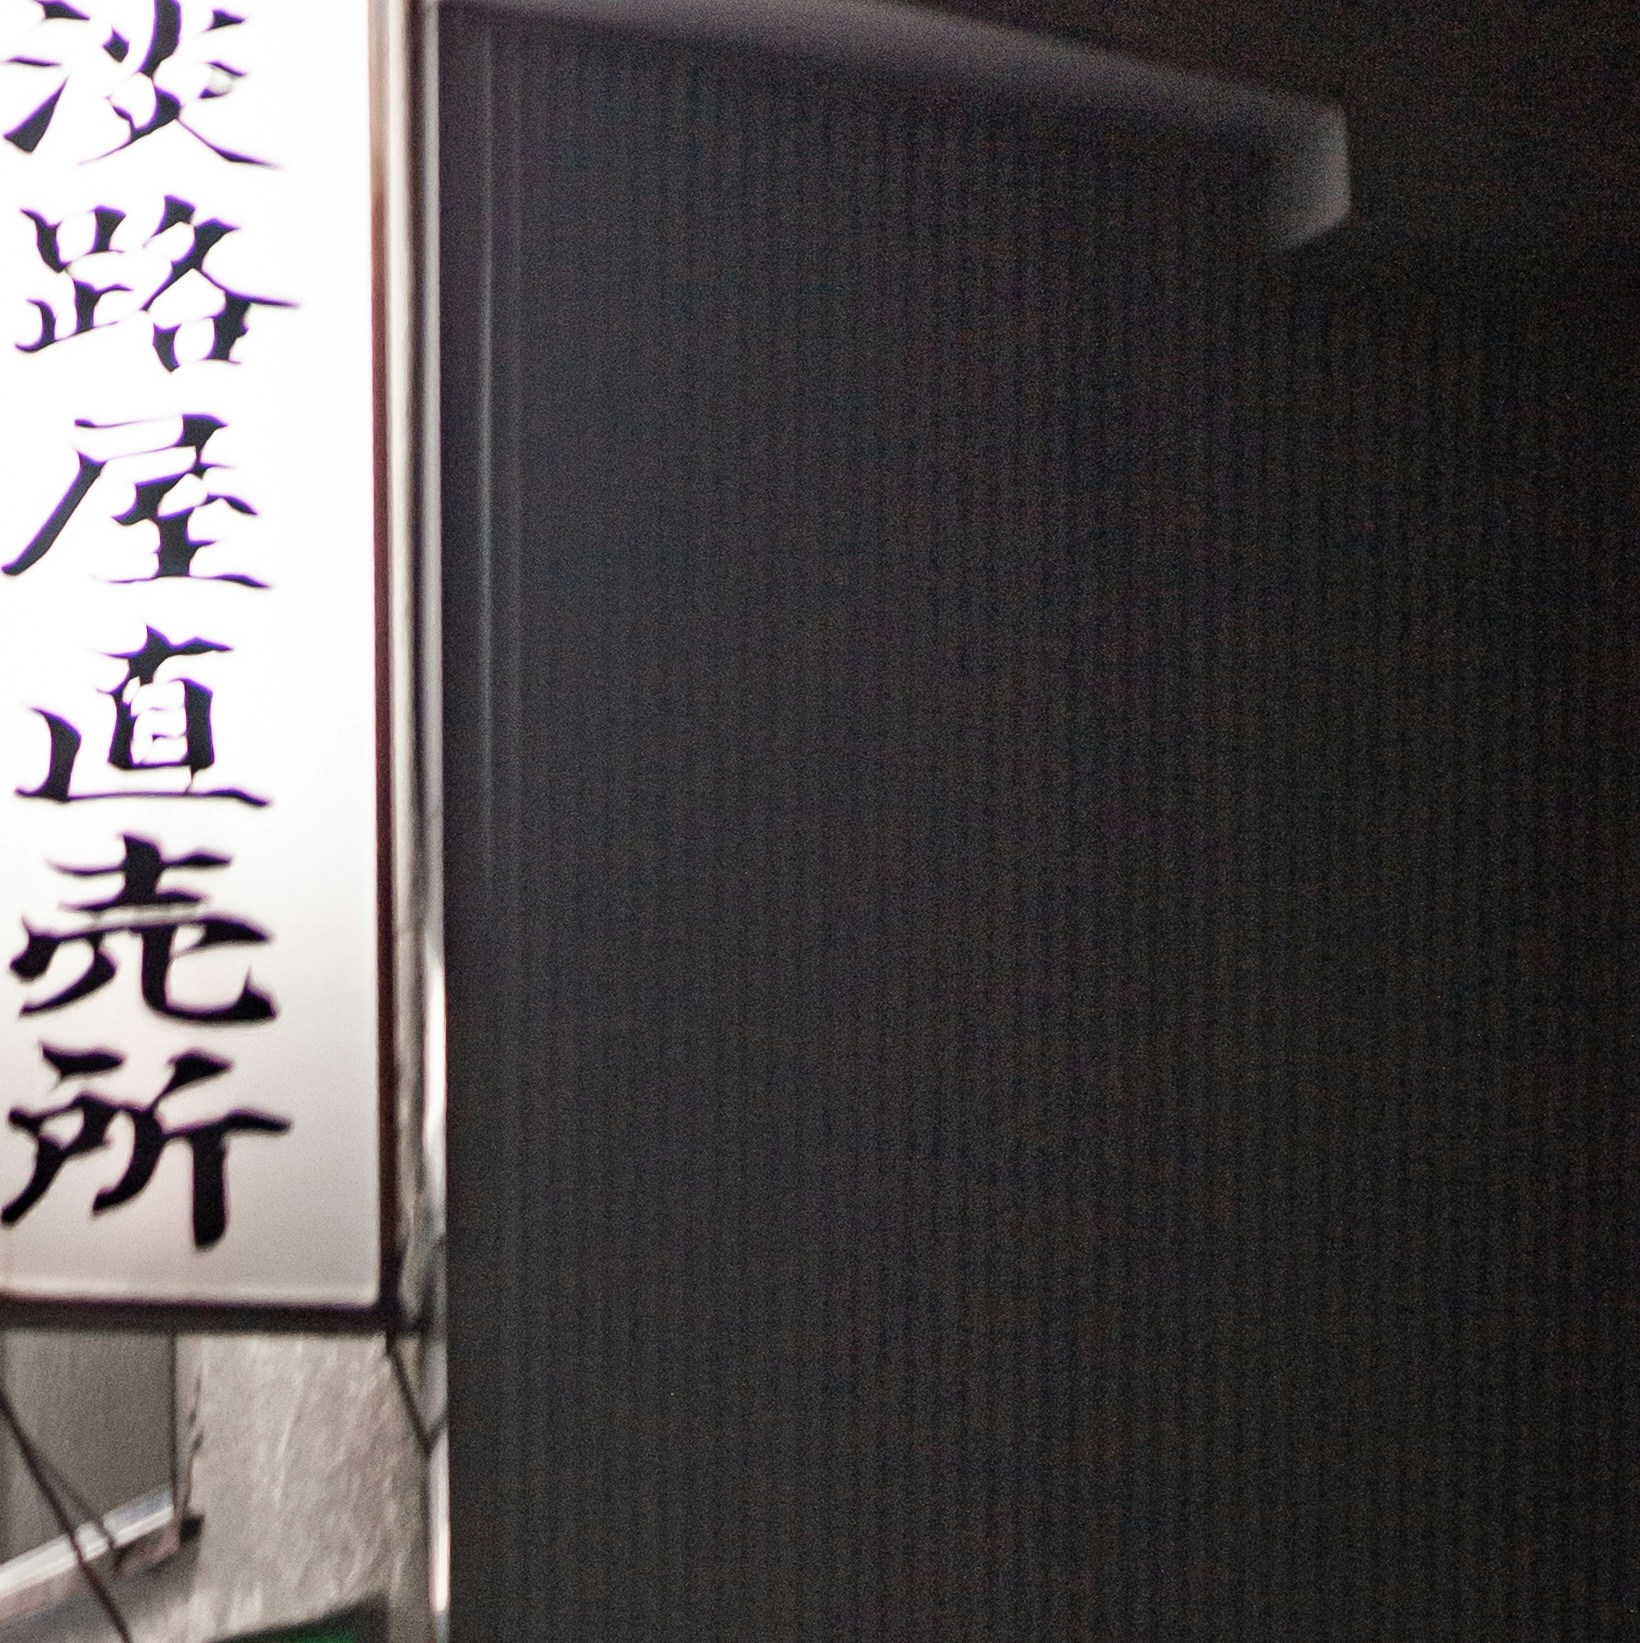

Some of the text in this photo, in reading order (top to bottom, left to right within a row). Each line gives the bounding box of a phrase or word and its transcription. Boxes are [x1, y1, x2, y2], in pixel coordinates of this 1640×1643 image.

[1, 0, 301, 1251] 淡路屋直売所
